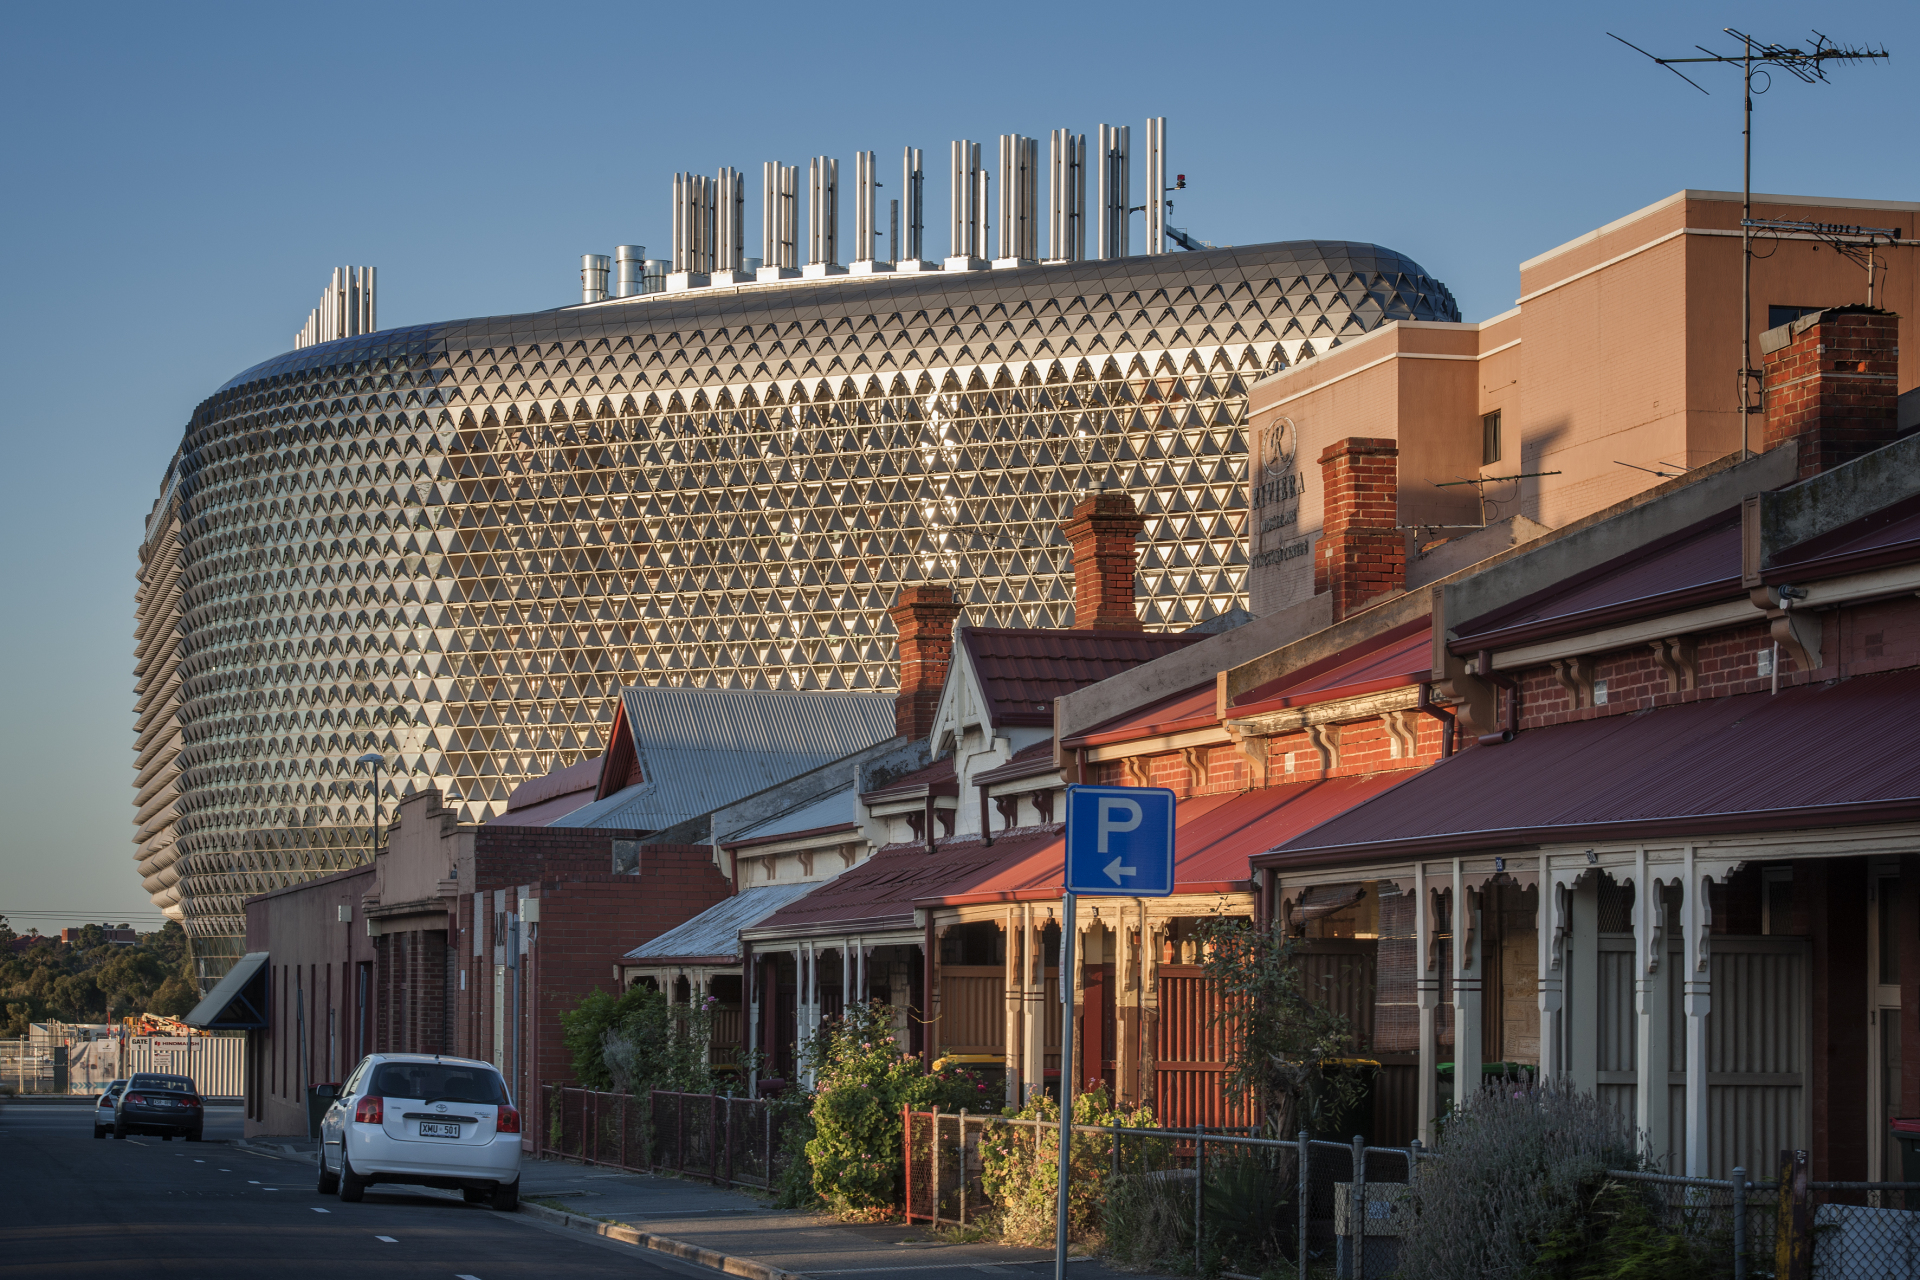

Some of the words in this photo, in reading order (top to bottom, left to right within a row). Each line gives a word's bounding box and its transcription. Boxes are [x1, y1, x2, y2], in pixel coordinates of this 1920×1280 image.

[1270, 425, 1290, 465] R
[1252, 471, 1305, 510] RIVIERA
[1097, 797, 1143, 853] P
[422, 1124, 438, 1133] XMU
[444, 1125, 458, 1135] 501
